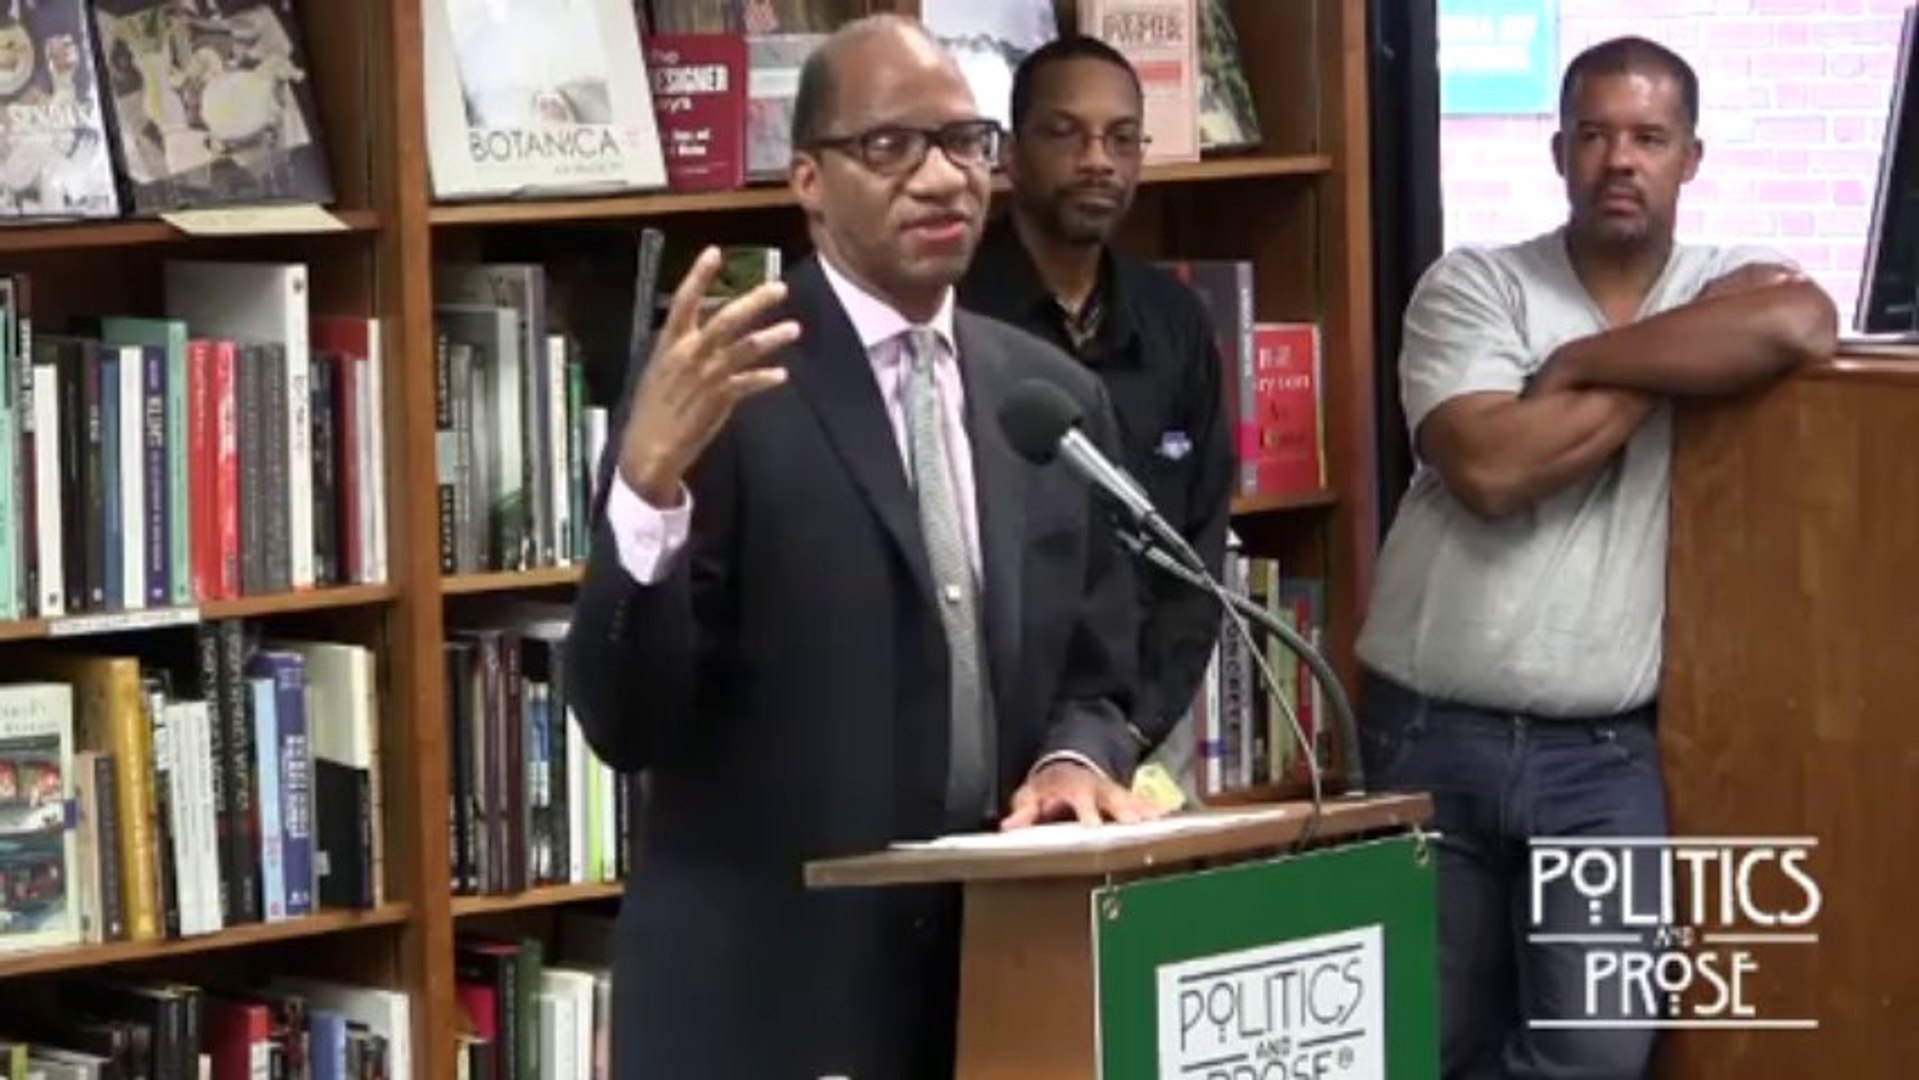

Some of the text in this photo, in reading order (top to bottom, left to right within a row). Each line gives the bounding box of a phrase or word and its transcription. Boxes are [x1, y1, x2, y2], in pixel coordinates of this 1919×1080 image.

[653, 64, 728, 93] ESIGNER
[468, 127, 620, 163] BOTANICA
[1256, 374, 1310, 396] ryson
[1180, 956, 1364, 1053] POLITICS
[1256, 1035, 1292, 1060] AND
[1207, 1050, 1332, 1080] OSE
